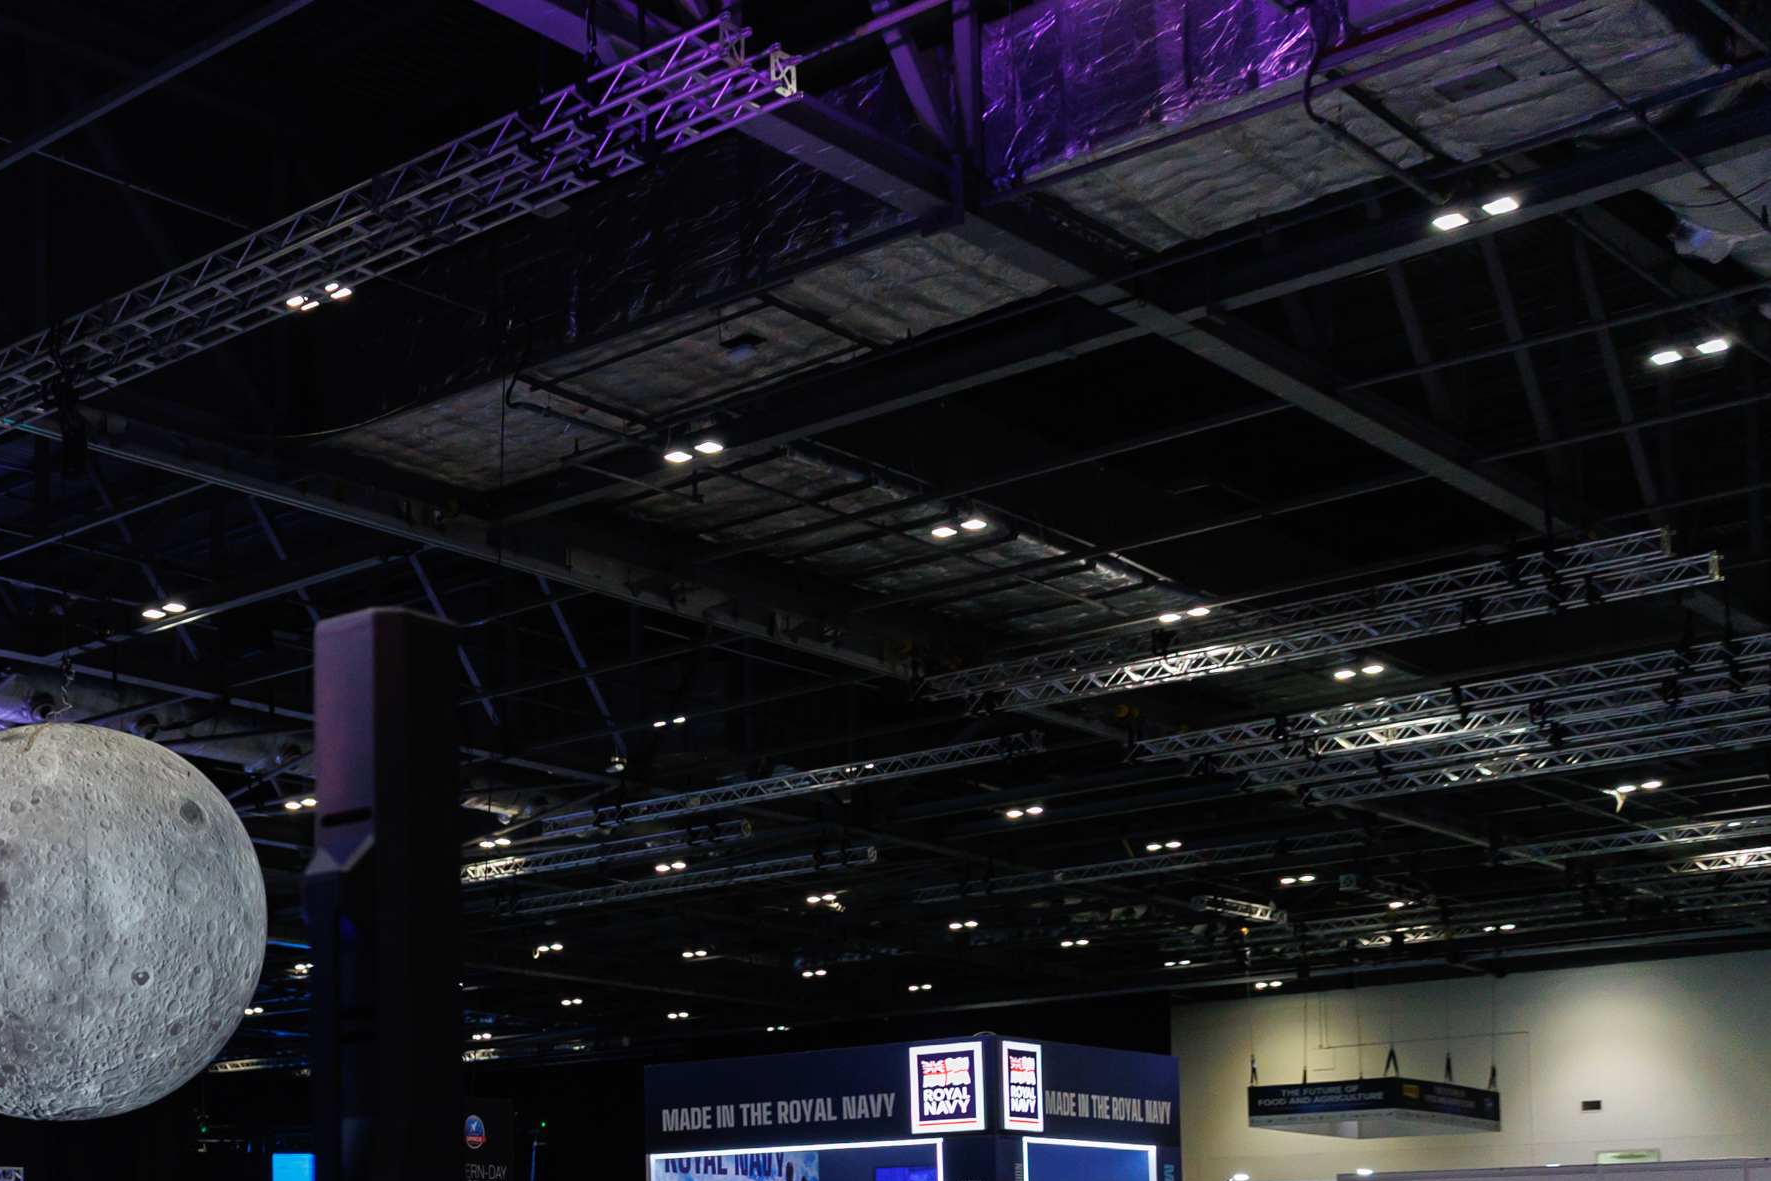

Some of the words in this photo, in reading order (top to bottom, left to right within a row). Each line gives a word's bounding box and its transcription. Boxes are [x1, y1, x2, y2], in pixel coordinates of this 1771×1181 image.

[923, 1086, 971, 1101] ROYAL
[1011, 1085, 1036, 1100] ROYAL
[1258, 1096, 1288, 1107] FOOD
[1289, 1095, 1311, 1105] AND
[1313, 1091, 1385, 1104] AGRICULTURE
[1282, 1088, 1301, 1098] THE
[1303, 1085, 1342, 1096] FUTURE
[1344, 1084, 1360, 1093] OF
[662, 1105, 712, 1132] MADE
[716, 1103, 735, 1129] IN
[740, 1101, 773, 1127] THE
[778, 1097, 838, 1125] ROYAL
[842, 1092, 896, 1119] NAVY
[924, 1100, 970, 1116] NAVY
[1011, 1098, 1036, 1113] NAVY
[1045, 1090, 1076, 1117] MADE
[1078, 1094, 1090, 1118] IN
[1092, 1094, 1110, 1120] THE
[1112, 1096, 1144, 1123] ROYAL
[1145, 1100, 1172, 1125] NAVY
[734, 1152, 785, 1178] NAVY
